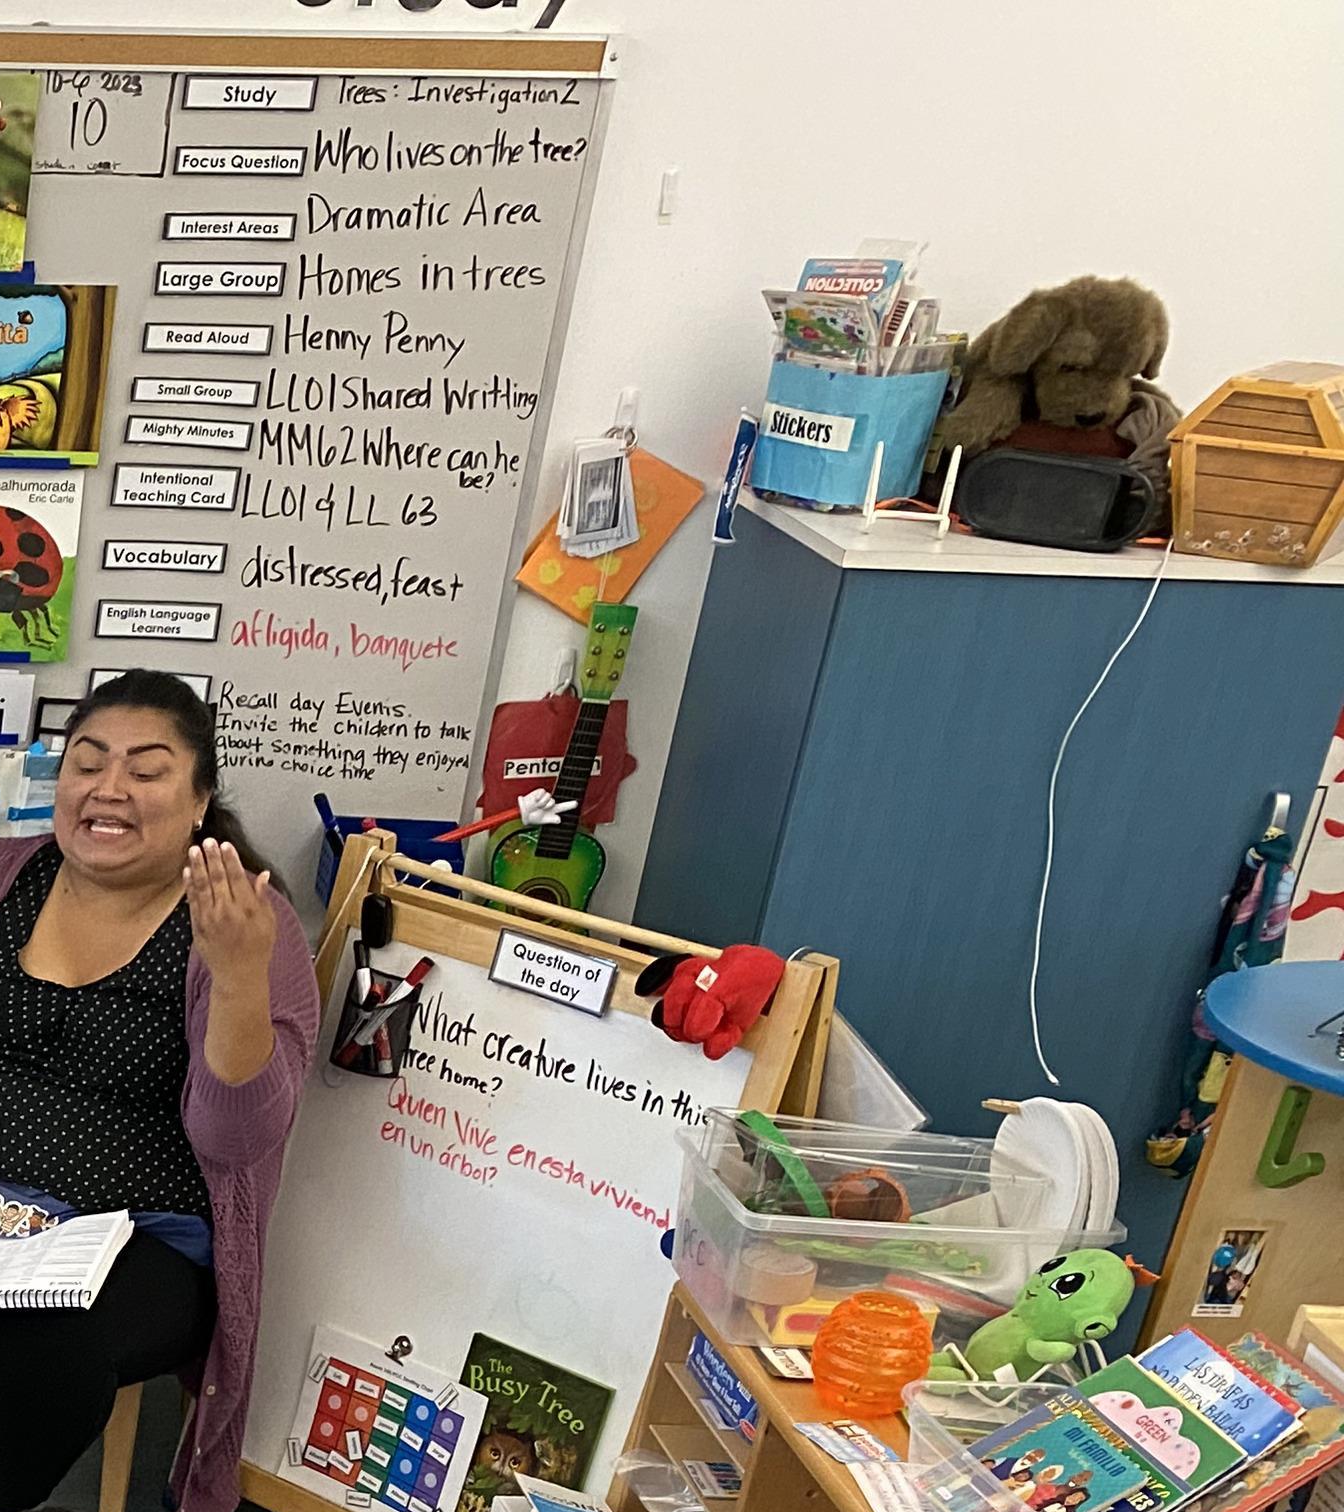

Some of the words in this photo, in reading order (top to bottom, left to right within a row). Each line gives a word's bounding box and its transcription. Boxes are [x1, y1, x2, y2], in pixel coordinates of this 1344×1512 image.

[224, 85, 277, 105] Study
[408, 76, 557, 113] Investigation
[182, 154, 225, 168] Focus
[230, 155, 299, 170] Question
[308, 193, 450, 234] Dramatic
[462, 186, 541, 227] Area
[180, 221, 234, 235] Interest
[237, 221, 279, 235] Areas
[162, 271, 213, 289] Large
[220, 272, 279, 291] Group
[299, 253, 401, 300] Homes
[422, 254, 453, 291] in
[462, 255, 546, 291] trees
[166, 331, 203, 343] Read
[207, 332, 249, 344] Aloud
[285, 313, 371, 360] Henny
[383, 310, 465, 368] Penny
[157, 384, 191, 396] Small
[194, 385, 233, 399] Group
[143, 423, 185, 437] Mighty
[187, 425, 234, 438] Minutes
[770, 410, 833, 443] Stickers
[140, 473, 213, 486] Intentional
[123, 489, 187, 505] Teaching
[191, 491, 225, 504] Card
[401, 493, 438, 527] 63
[113, 548, 218, 569] Vocabulary
[107, 607, 147, 619] English
[150, 609, 211, 622] Language
[132, 623, 181, 634] Learners
[350, 623, 459, 672] banquete
[219, 680, 277, 710] Recall
[216, 735, 263, 750] about
[513, 943, 581, 976] Question
[521, 969, 546, 988] the
[550, 978, 580, 1001] day
[483, 1032, 576, 1083] creature
[438, 1143, 498, 1188] árbol?
[1183, 1357, 1210, 1385] LAS
[470, 1363, 530, 1406] Busy
[534, 1380, 586, 1436] Tree
[1063, 1427, 1081, 1444] MI
[1136, 1415, 1170, 1443] GREEN
